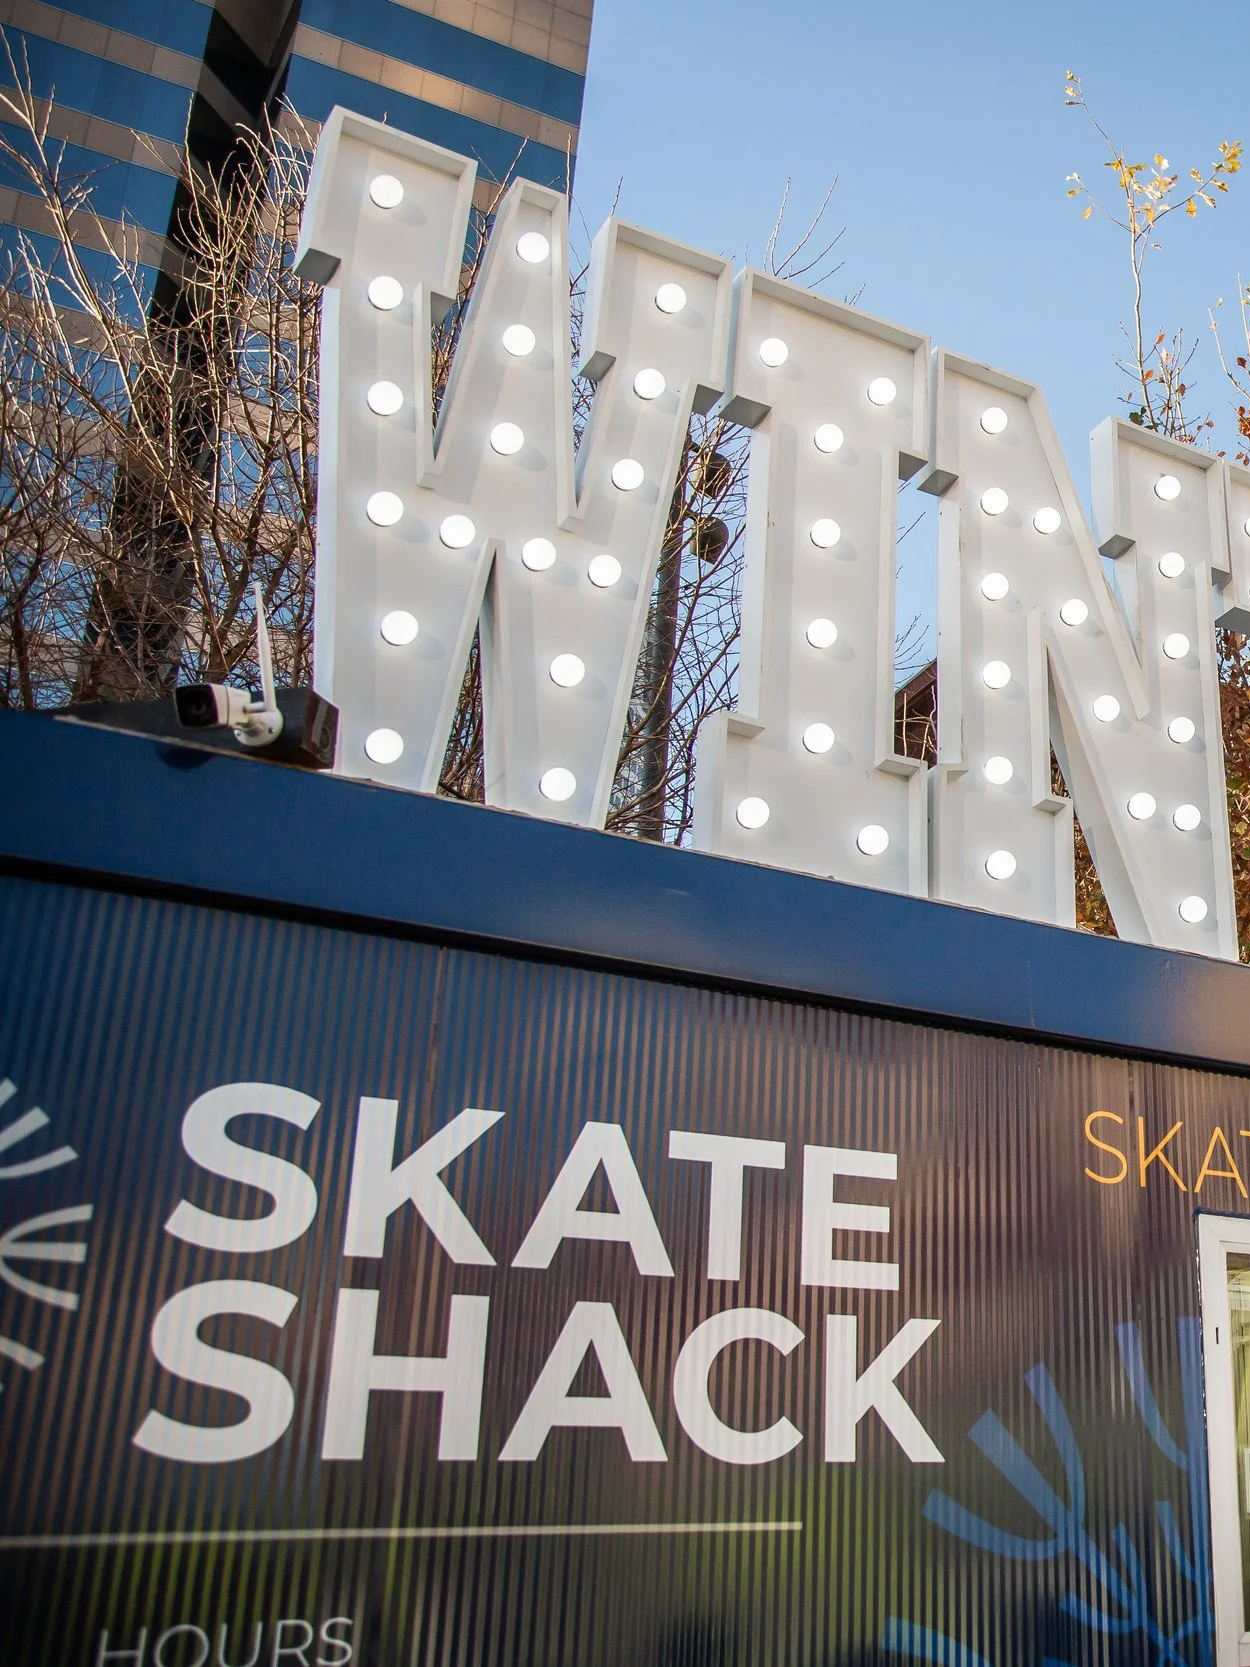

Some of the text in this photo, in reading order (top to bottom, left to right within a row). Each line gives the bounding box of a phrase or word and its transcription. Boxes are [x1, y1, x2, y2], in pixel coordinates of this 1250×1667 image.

[164, 1081, 899, 1292] SKATE
[131, 1279, 946, 1466] SHACK
[95, 1617, 354, 1667] HOURS
